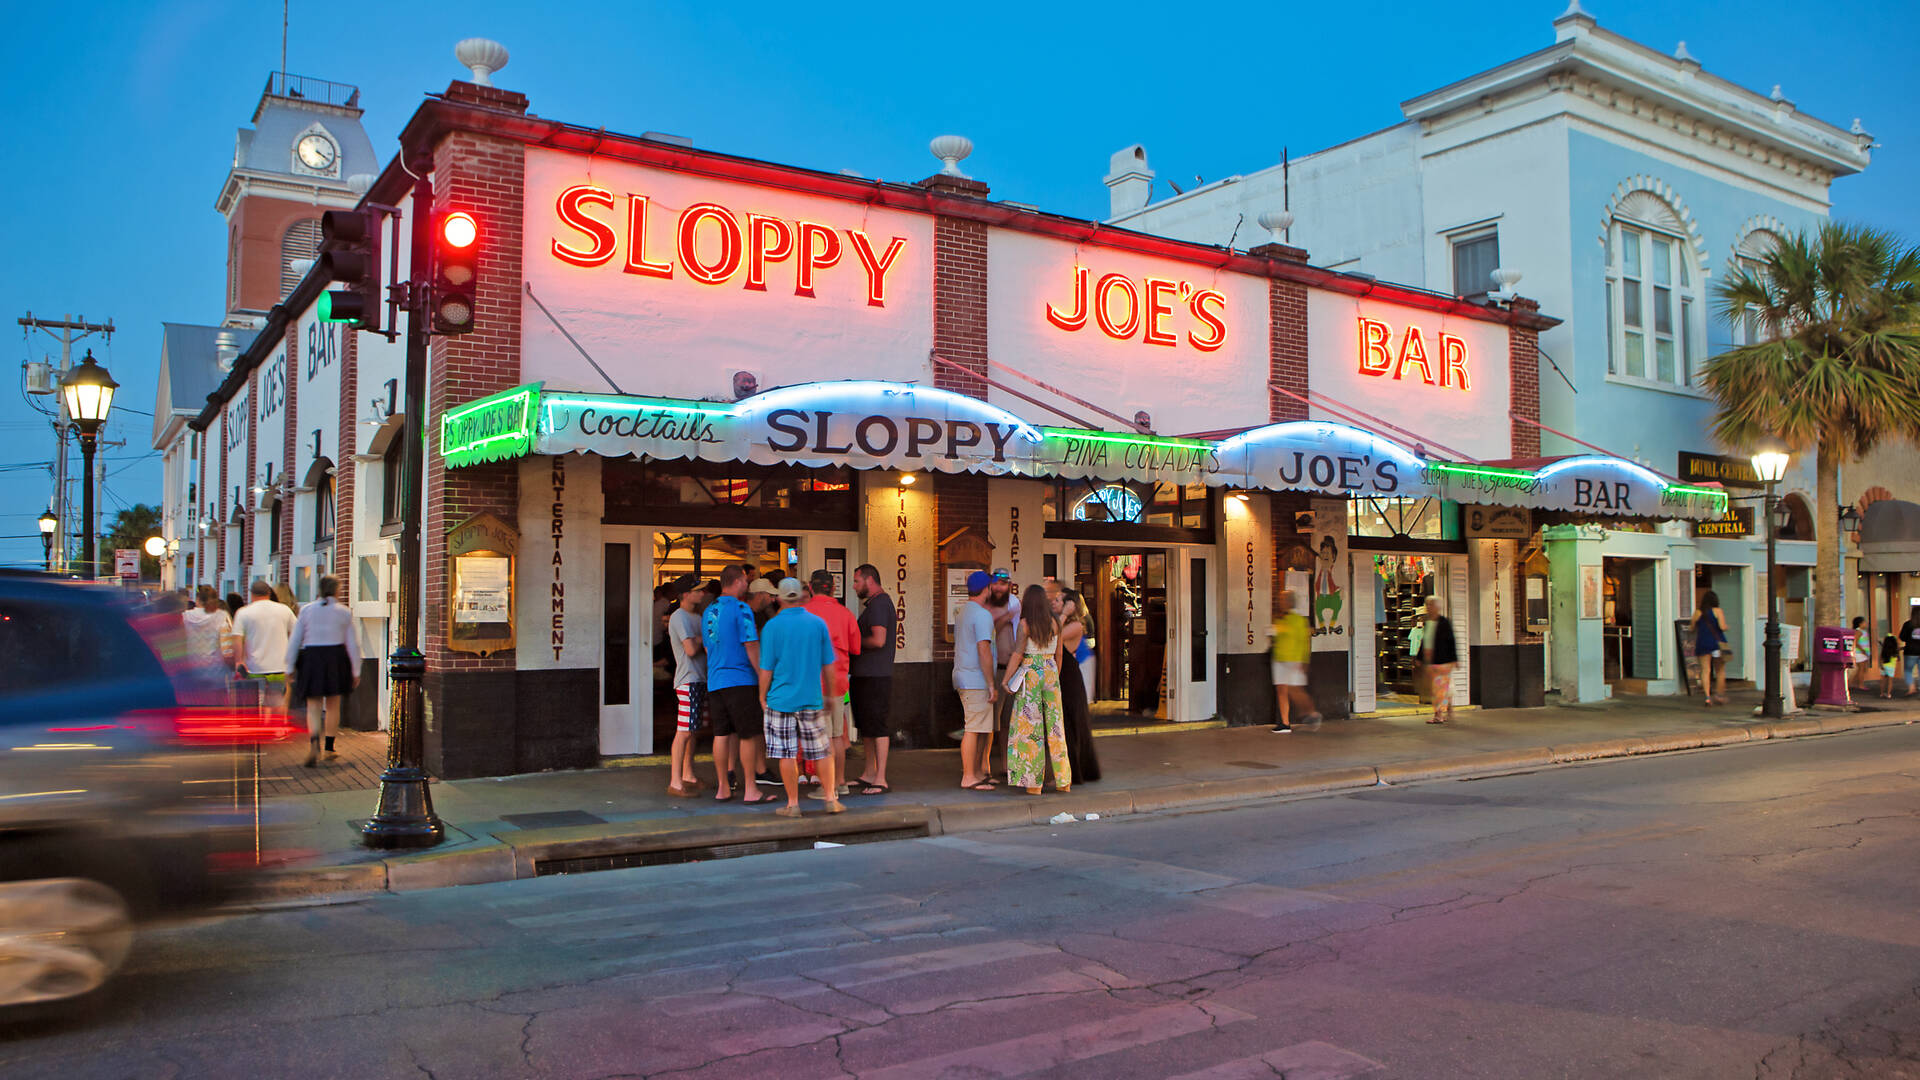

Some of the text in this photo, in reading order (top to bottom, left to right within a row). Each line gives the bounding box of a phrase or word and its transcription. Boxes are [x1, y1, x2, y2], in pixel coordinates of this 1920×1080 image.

[551, 184, 908, 308] SLOPPY
[1046, 265, 1227, 352] JOE'S
[308, 320, 337, 383] BAR
[1357, 316, 1472, 391] BAR
[260, 353, 286, 423] JOE'S
[228, 396, 249, 453] SLOPP
[449, 416, 478, 447] SOPPY
[579, 407, 725, 443] Cocktails
[766, 409, 1020, 463] SLOPPY
[1279, 451, 1399, 492] JOE'S
[1574, 478, 1632, 511] BAR
[551, 454, 565, 661] ENTERTAINMENT
[1010, 506, 1020, 572] DRAFT
[1698, 522, 1746, 535] CENTRAL
[895, 553, 907, 650] COLADAS
[1246, 541, 1255, 646] COCKTAILS
[1493, 541, 1501, 641] ERTAINMENT
